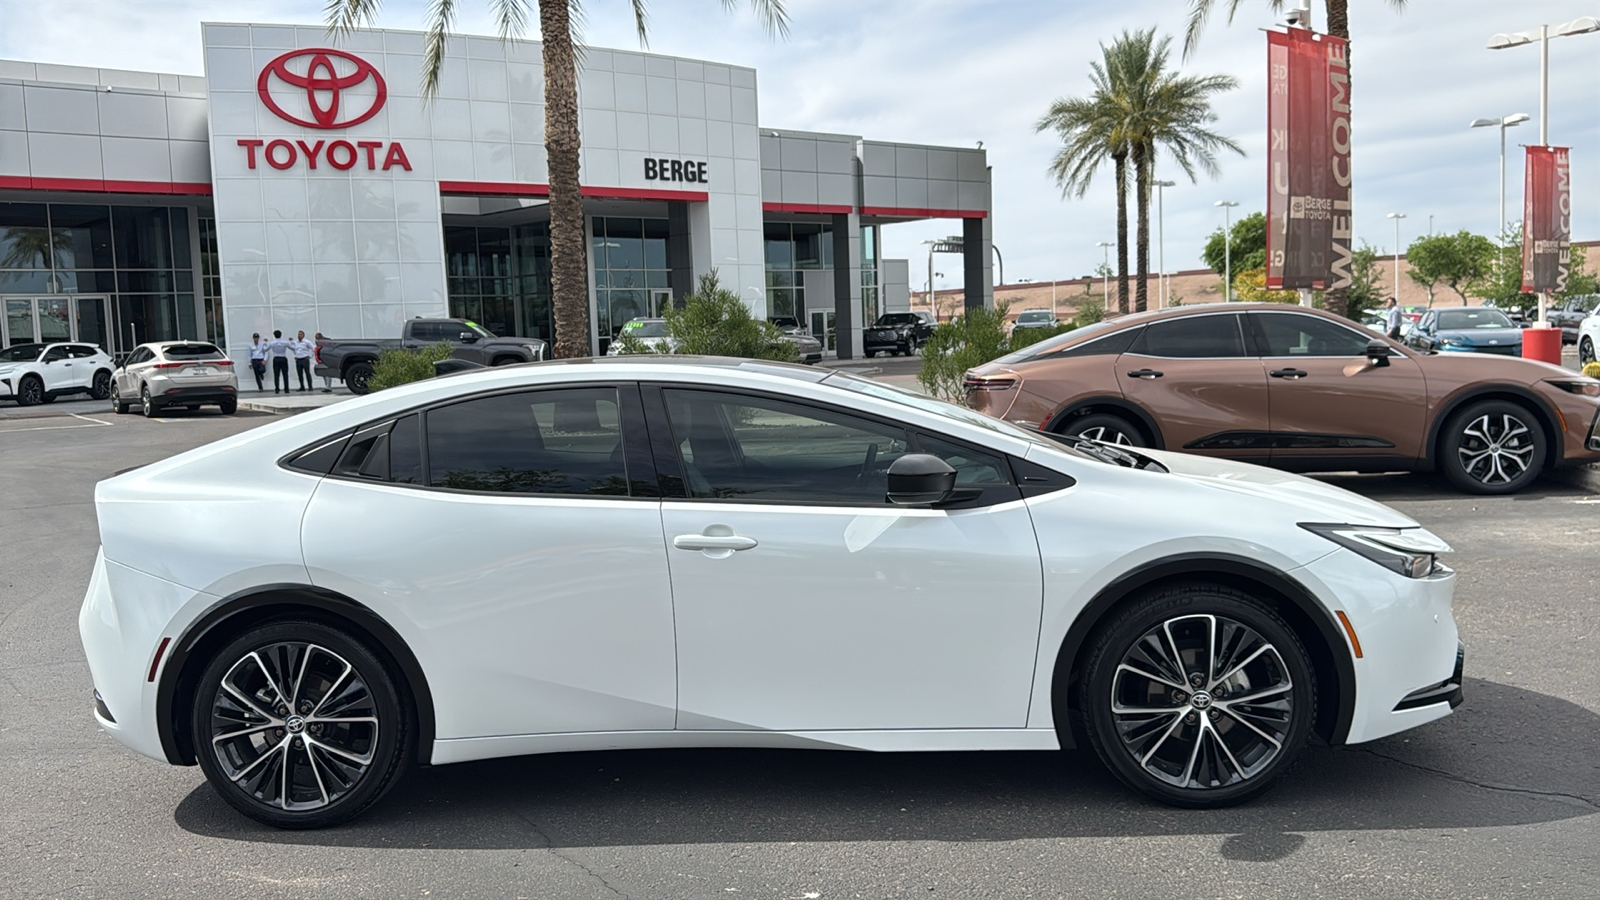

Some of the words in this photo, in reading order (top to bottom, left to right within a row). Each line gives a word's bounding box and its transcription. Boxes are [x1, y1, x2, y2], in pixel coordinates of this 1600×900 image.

[237, 139, 413, 171] TOYOTA
[644, 158, 708, 183] BERGE
[1325, 42, 1352, 293] WELCOME
[1305, 210, 1331, 220] TOYOTA
[1555, 150, 1570, 292] WELCOME
